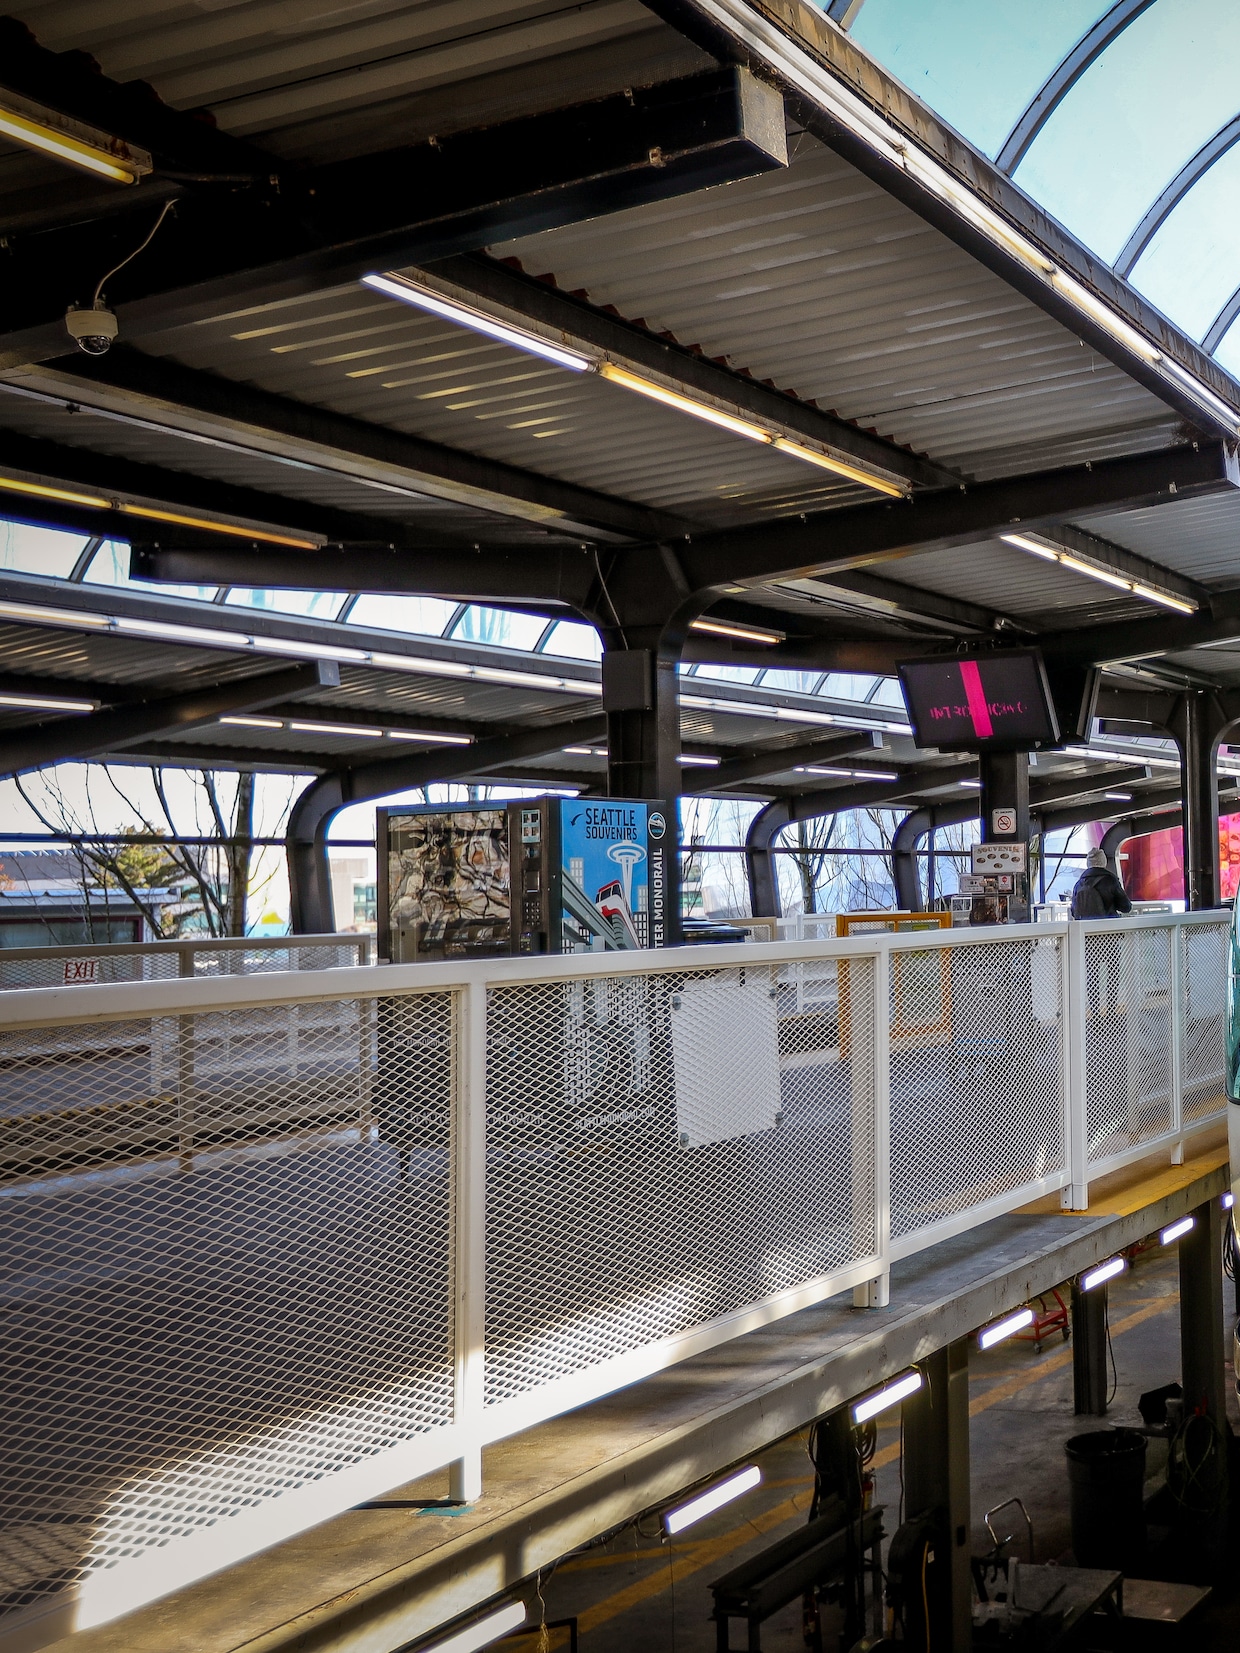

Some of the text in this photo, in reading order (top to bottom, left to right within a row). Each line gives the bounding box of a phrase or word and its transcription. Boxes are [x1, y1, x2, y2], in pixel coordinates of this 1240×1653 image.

[585, 808, 636, 827] SEATTLE
[585, 826, 638, 840] SOUVENIRS
[653, 847, 664, 949] TER MONORAIL
[65, 961, 97, 979] EXIT
